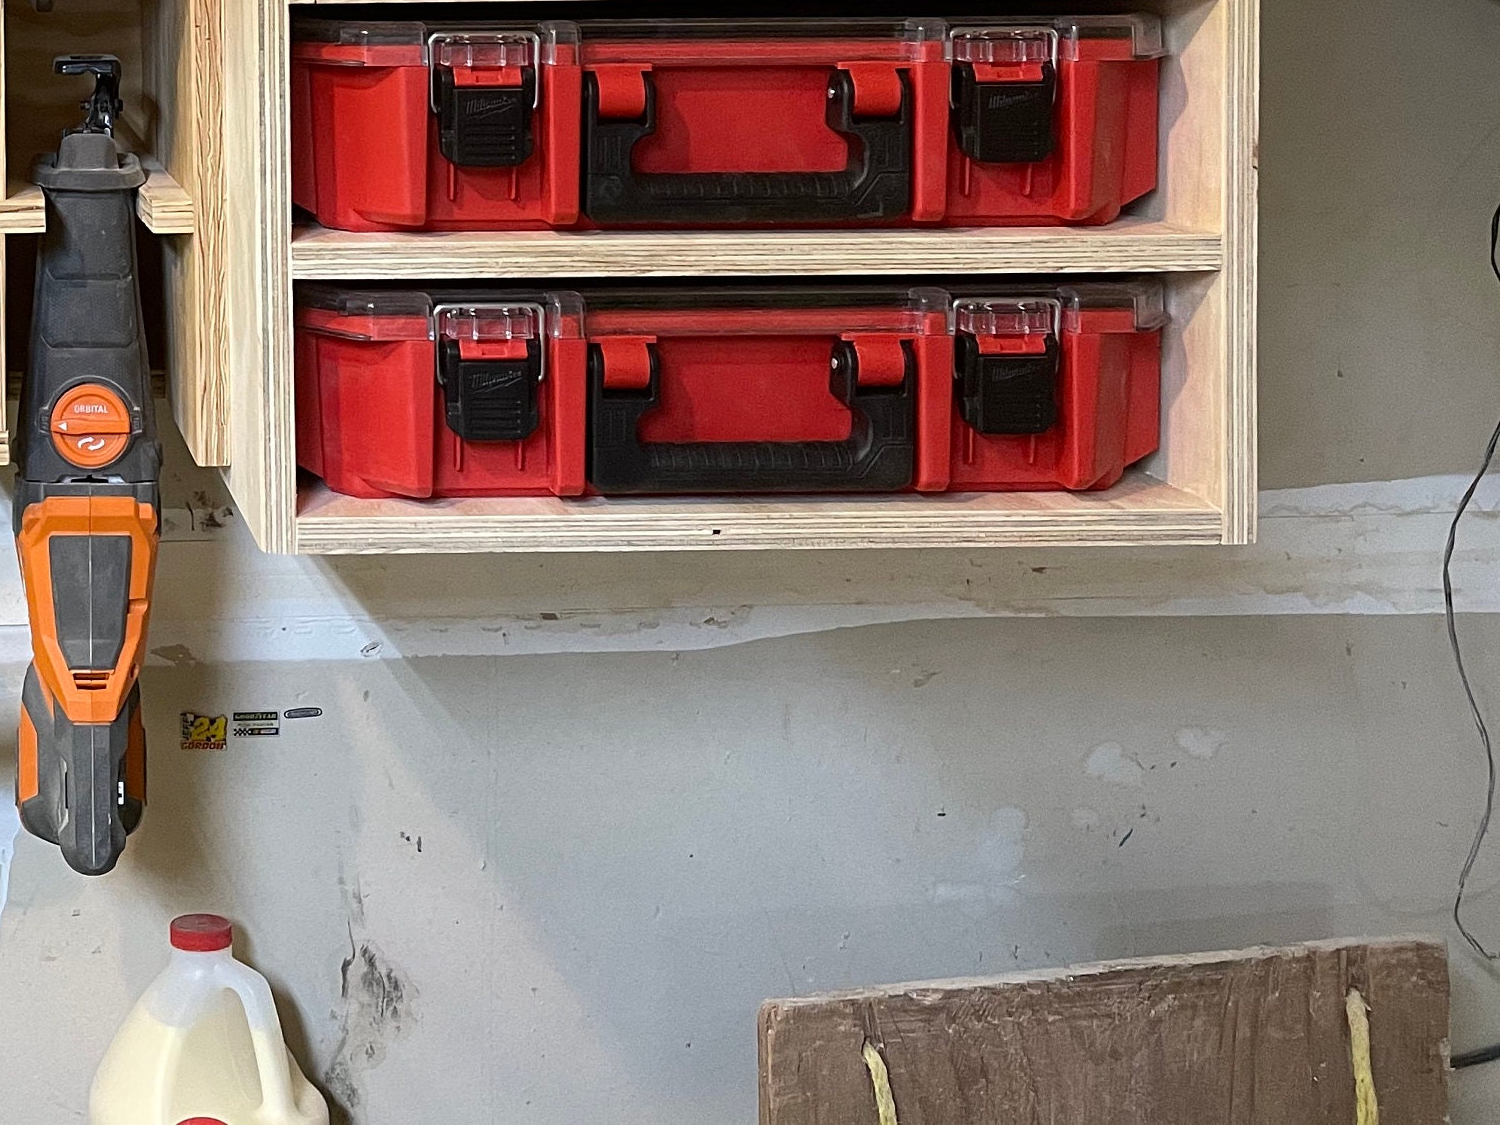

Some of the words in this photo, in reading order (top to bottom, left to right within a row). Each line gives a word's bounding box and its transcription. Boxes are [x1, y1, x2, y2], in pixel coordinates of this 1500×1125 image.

[74, 404, 109, 414] ORBITAL
[192, 716, 227, 741] 24
[181, 741, 224, 750] GORDON
